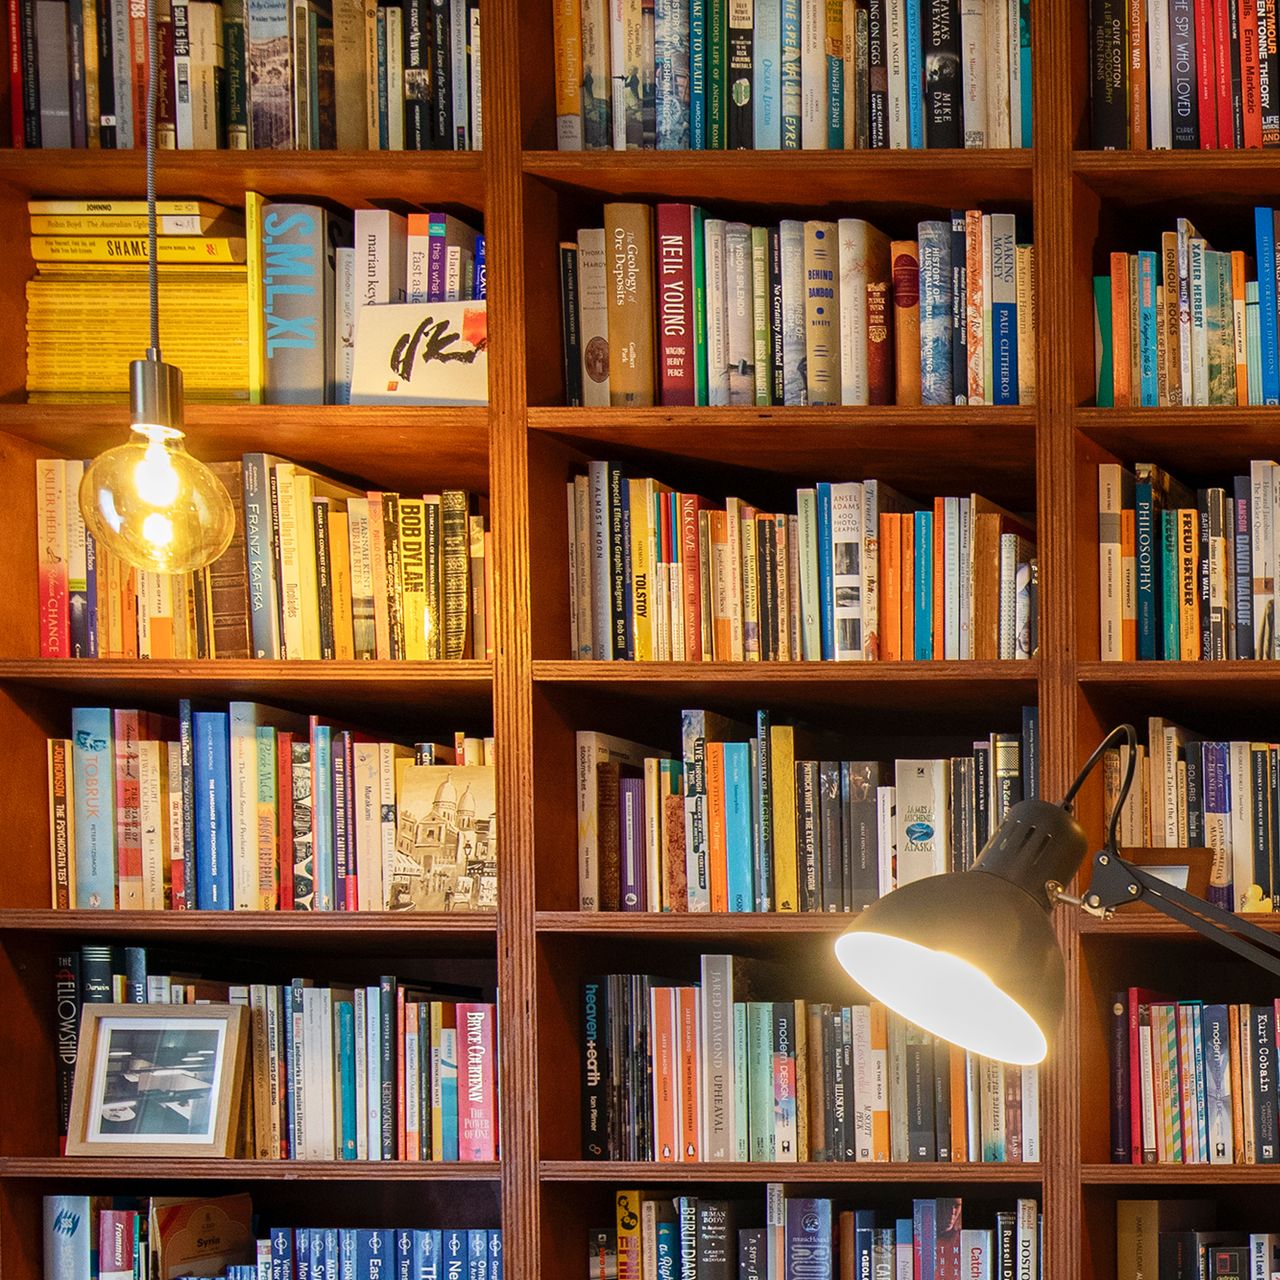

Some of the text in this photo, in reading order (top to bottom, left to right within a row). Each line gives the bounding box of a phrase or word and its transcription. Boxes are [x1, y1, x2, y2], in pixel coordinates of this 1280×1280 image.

[107, 241, 149, 256] SHAME
[614, 228, 627, 305] Ore Deposits
[264, 213, 316, 358] S,M,L,XL
[449, 251, 458, 298] blackout
[663, 235, 685, 336] NEIL YOUNG
[999, 309, 1011, 398] PAUL CLITHEROE
[45, 468, 57, 543] KILLER HEELS
[612, 471, 621, 505] Unspecial
[614, 508, 622, 531] Effects
[248, 504, 264, 610] FRANZ KAFKA
[402, 505, 423, 592] BOB DYLAN
[613, 545, 622, 573] Graphic
[1138, 502, 1151, 592] PHILOSOPHY
[615, 575, 624, 611] Designers
[636, 573, 648, 617] TOLSTOY
[85, 755, 100, 819] TOBRUK
[335, 758, 344, 772] BEST
[335, 775, 344, 808] AUSTRALIAN
[364, 786, 373, 821] Murakami
[56, 805, 67, 885] THE PSYCHOPATH TEST
[336, 811, 345, 835] POLITICAL
[337, 837, 346, 864] CARTOONS
[466, 1012, 485, 1101] BRYCE COURTENAY
[1258, 1015, 1270, 1092] Kurt Cobain
[115, 1223, 124, 1265] Frommer's
[1003, 1230, 1012, 1267] Russell
